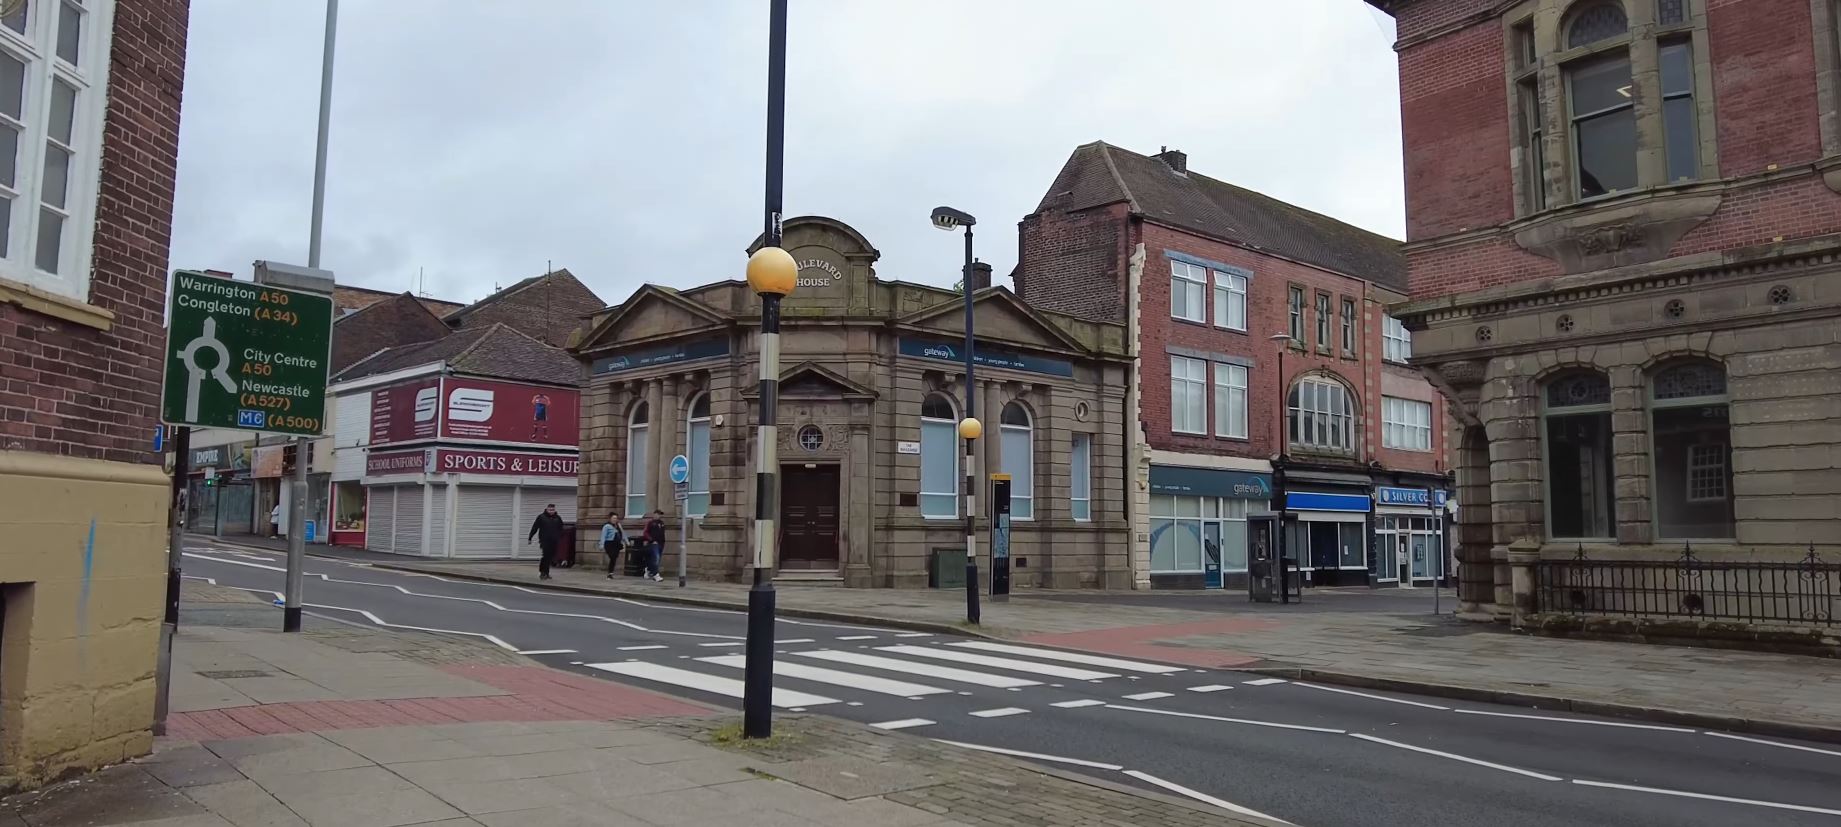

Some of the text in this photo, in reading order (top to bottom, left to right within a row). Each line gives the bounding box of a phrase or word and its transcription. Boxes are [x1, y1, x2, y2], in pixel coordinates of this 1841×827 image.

[797, 259, 842, 280] ULEVARD
[180, 276, 289, 305] Warrington A50
[796, 278, 830, 287] HOUSE
[178, 294, 298, 326] Congleton (A34)
[243, 348, 317, 368] City Centre
[924, 347, 949, 359] gateway
[241, 362, 272, 376] A50
[242, 380, 310, 398] Newcastle
[240, 393, 291, 411] (A527)
[240, 411, 319, 431] M6 (A500)
[368, 459, 391, 471] SCHOOL
[391, 455, 423, 469] UNIFORMS
[444, 454, 506, 471] SPORTS
[510, 458, 523, 472] &
[528, 459, 580, 473] LEISUR
[1233, 483, 1263, 496] gateway
[1392, 491, 1416, 502] SILVER
